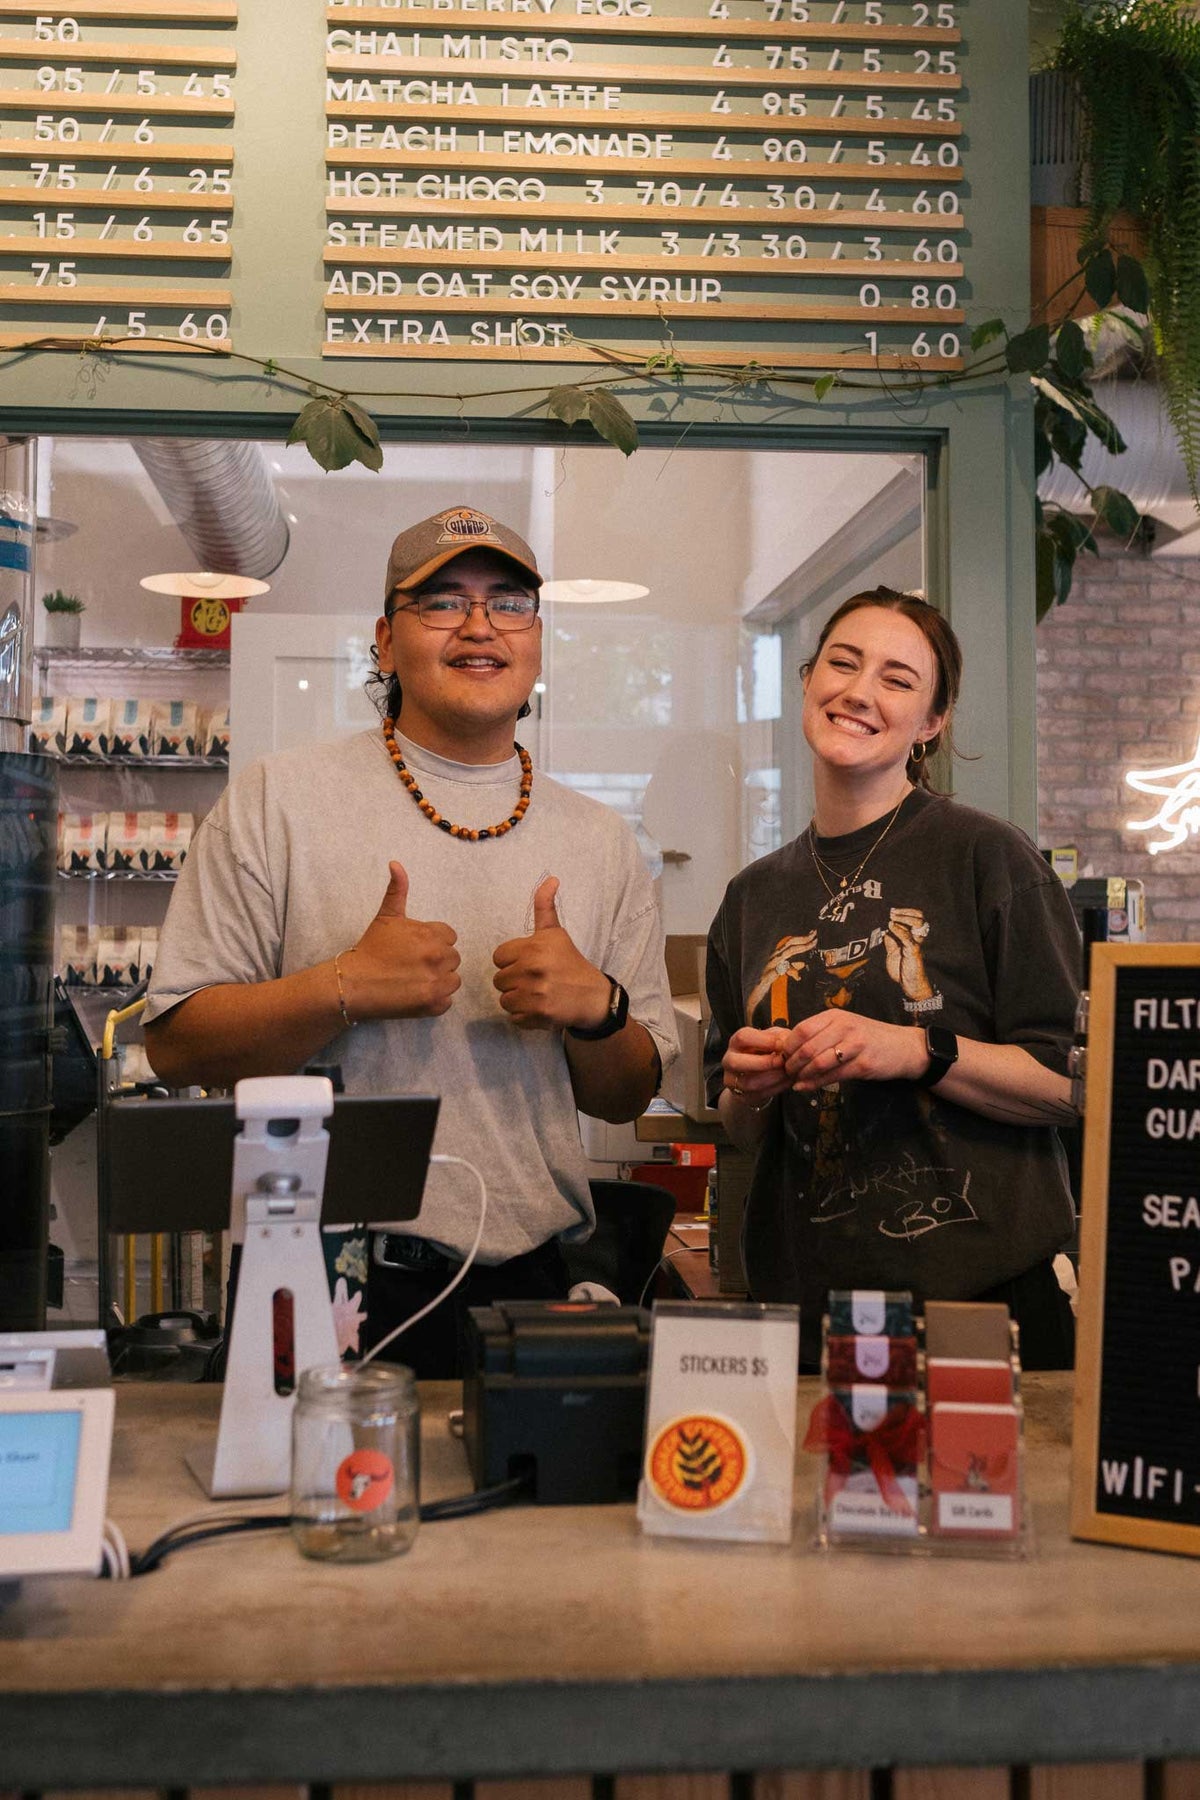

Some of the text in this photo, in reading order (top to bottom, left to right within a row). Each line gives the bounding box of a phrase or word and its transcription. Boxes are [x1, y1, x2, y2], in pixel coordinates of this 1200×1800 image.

[326, 30, 420, 57] CHAI
[443, 34, 573, 63] MISTO
[326, 79, 479, 106] MATCHA
[502, 83, 621, 110] LATTE
[328, 124, 456, 152] PEACH
[478, 130, 673, 159] LEMONADE
[328, 171, 403, 199] HOT
[416, 174, 546, 203] CHOCO
[328, 222, 503, 251] STEAMED
[520, 227, 621, 254] MILK
[327, 270, 402, 297] ADD
[416, 272, 492, 298] OAT
[509, 275, 582, 301] SOY
[600, 276, 722, 304] SYRUP
[326, 317, 450, 345] EXTRA
[471, 321, 567, 348] SHOT
[1133, 998, 1200, 1030] FILT
[680, 1355, 747, 1375] STICKERS
[1101, 1456, 1184, 1505] WIFI
